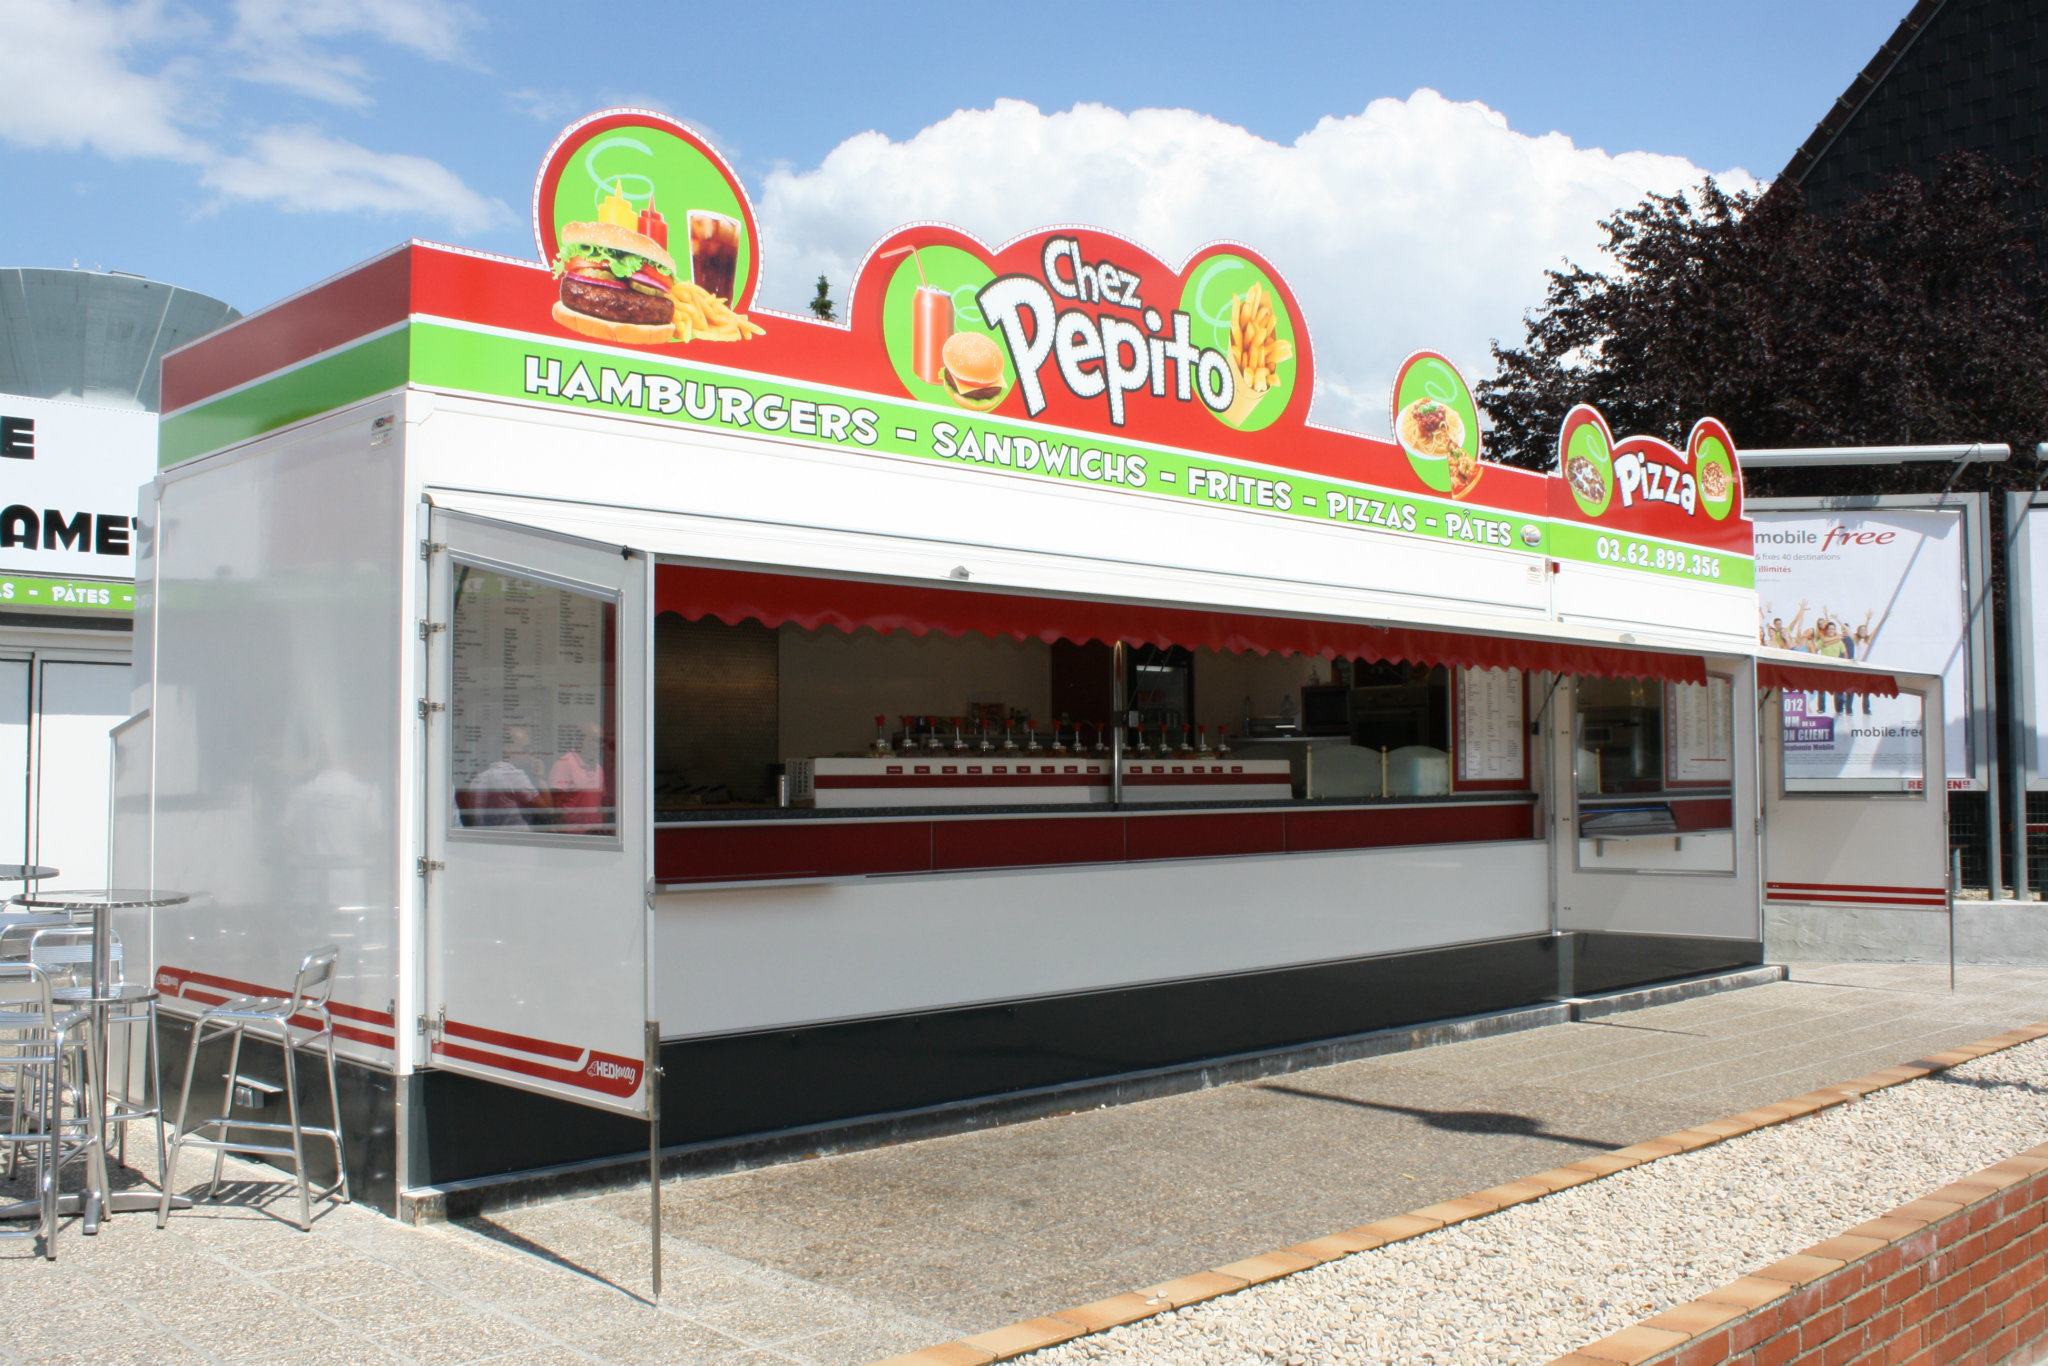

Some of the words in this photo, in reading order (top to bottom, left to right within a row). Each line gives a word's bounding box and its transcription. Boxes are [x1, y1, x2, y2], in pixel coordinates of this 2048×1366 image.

[1041, 235, 1143, 309] Chez
[975, 273, 1234, 427] Pepito
[524, 355, 879, 446] HAMBURGERS
[932, 422, 1148, 487] SANDWICHS
[1187, 466, 1292, 511] FRITES
[1326, 491, 1417, 532] PIZZAS
[1445, 509, 1512, 547] PÂTES
[1613, 451, 1696, 516] Pizza
[0, 504, 137, 556] AME
[1755, 530, 1817, 544] mobile
[1821, 526, 1896, 552] free
[1596, 536, 1720, 578] 03.62.899.356
[1793, 552, 1841, 561] destinations
[52, 583, 110, 605] PÂTES
[1784, 698, 1803, 712] 012
[1797, 728, 1830, 741] CLIENT
